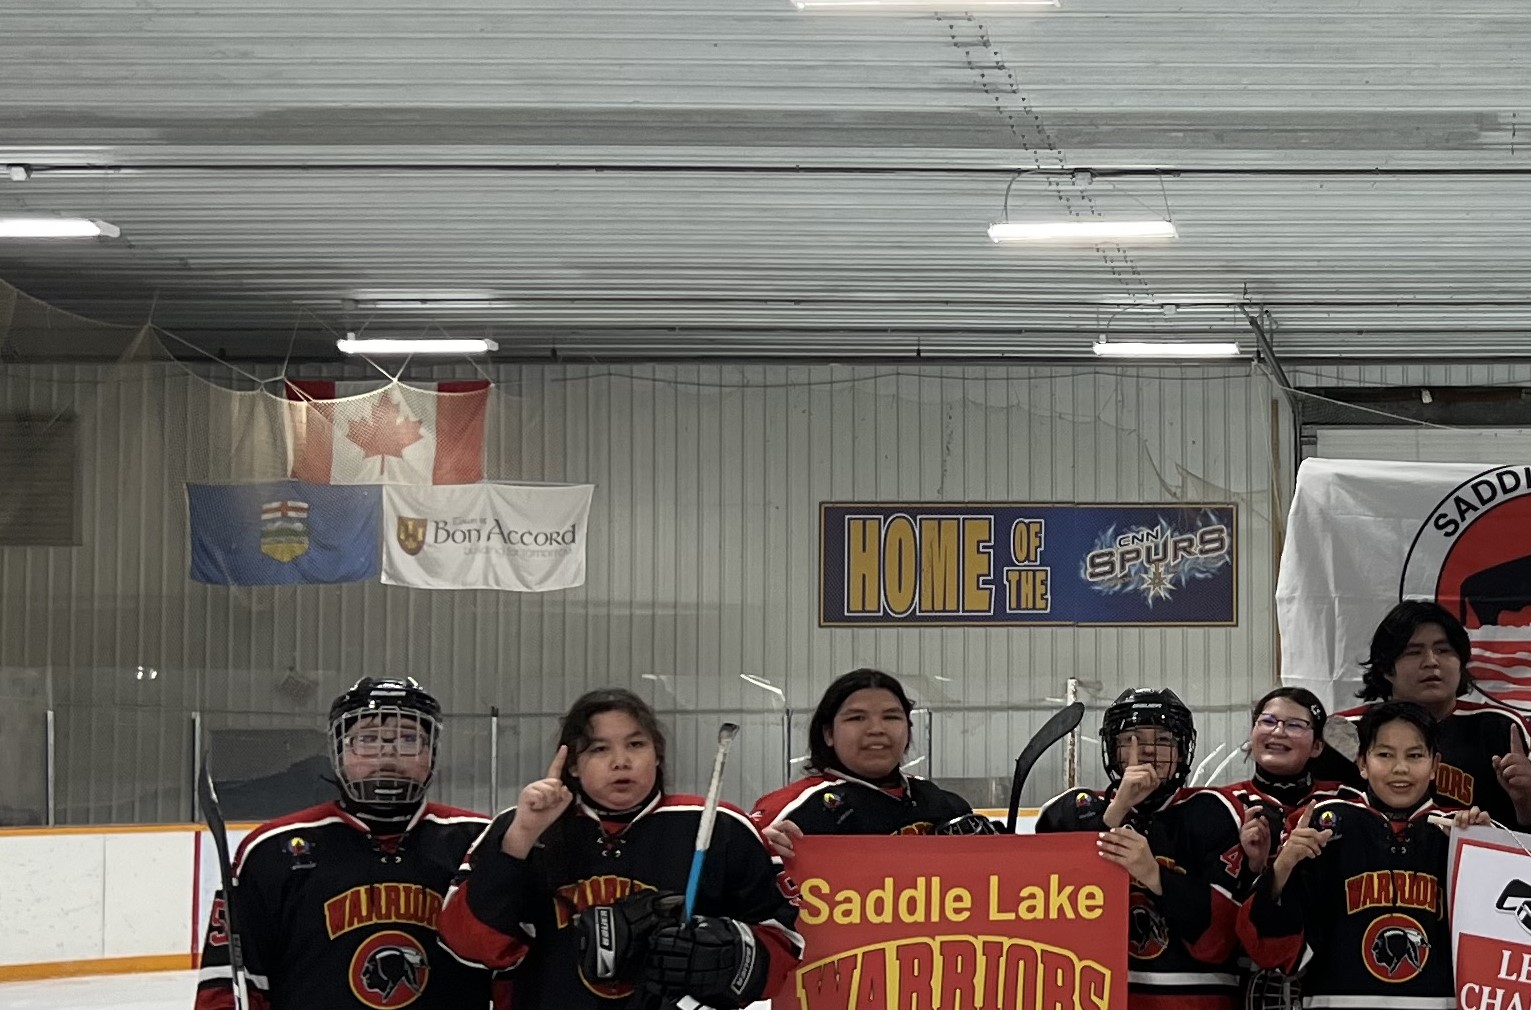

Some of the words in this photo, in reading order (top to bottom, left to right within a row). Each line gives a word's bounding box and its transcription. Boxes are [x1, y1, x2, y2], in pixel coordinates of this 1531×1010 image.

[433, 520, 481, 545] Bon
[486, 518, 577, 547] Accord
[1010, 517, 1046, 565] OF
[1086, 525, 1230, 582] SPURS
[1117, 528, 1160, 548] CNN
[844, 514, 994, 617] HOME
[1004, 566, 1051, 614] THE
[323, 882, 446, 941] WARRIOR
[799, 876, 971, 926] Saddle
[989, 873, 1104, 921] Lake
